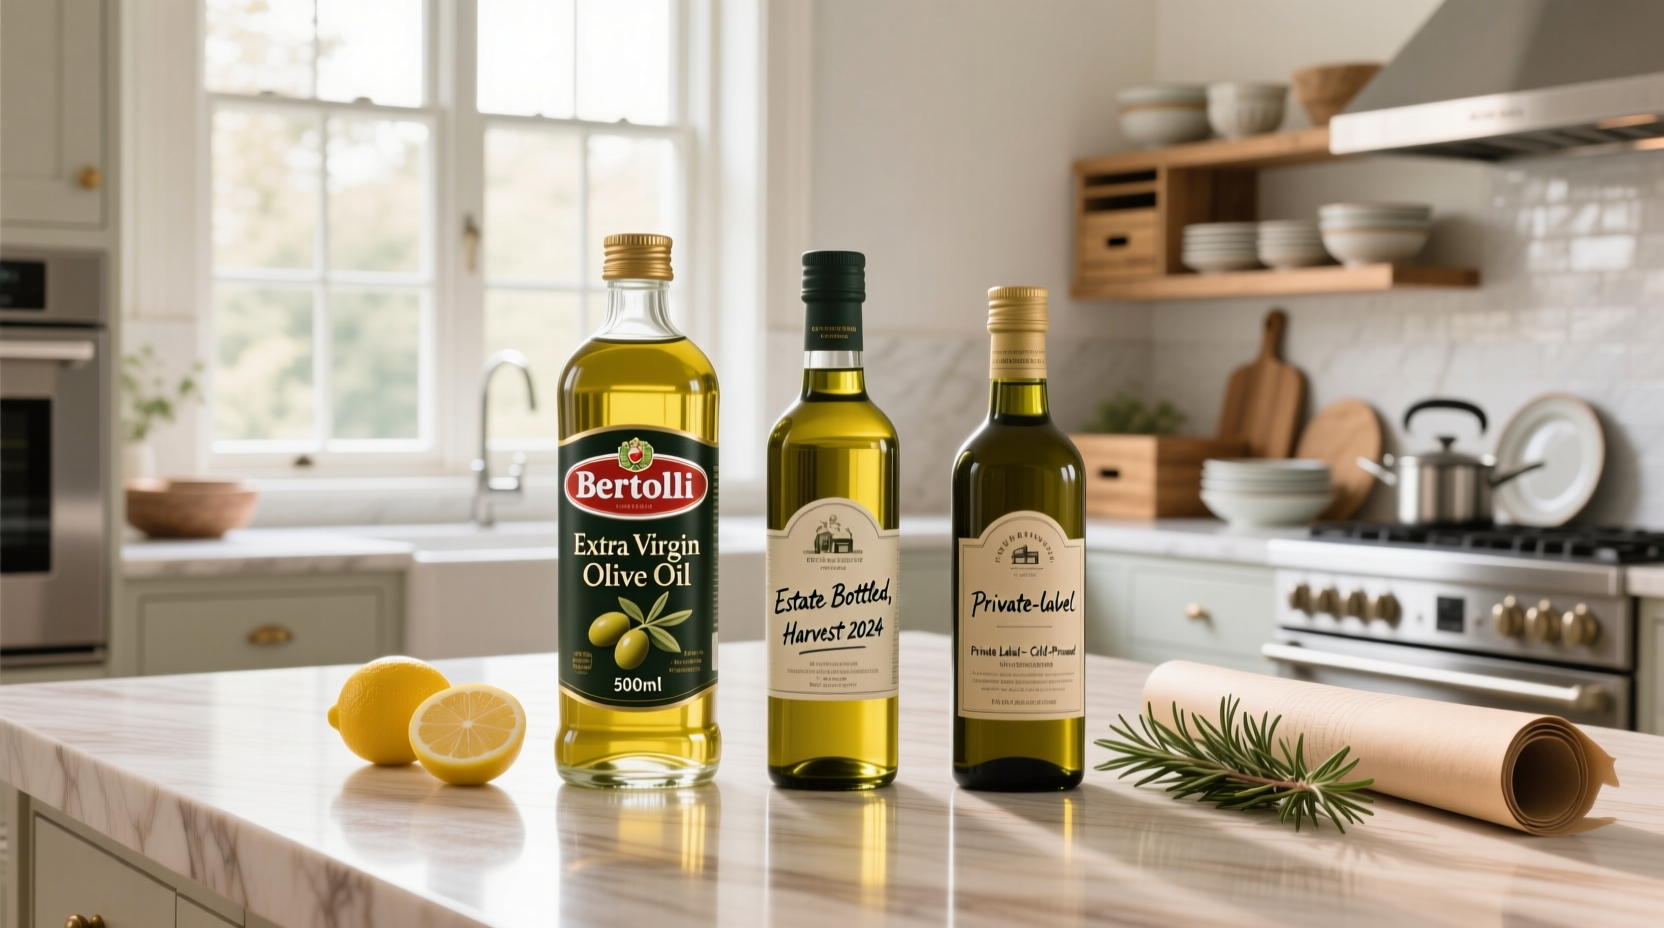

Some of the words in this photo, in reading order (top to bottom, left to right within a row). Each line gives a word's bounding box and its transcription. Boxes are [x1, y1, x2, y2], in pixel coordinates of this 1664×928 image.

[575, 470, 694, 499] Bertolli
[573, 532, 630, 556] Extra
[632, 532, 701, 563] Virgin
[582, 562, 648, 587] Olive
[653, 562, 692, 587] Oil
[774, 587, 827, 614] Estate
[830, 577, 892, 609] Bottled,
[971, 590, 1075, 618] Private-label
[782, 620, 845, 646] Harvest
[847, 616, 884, 640] 2024
[613, 676, 663, 692] 500ml
